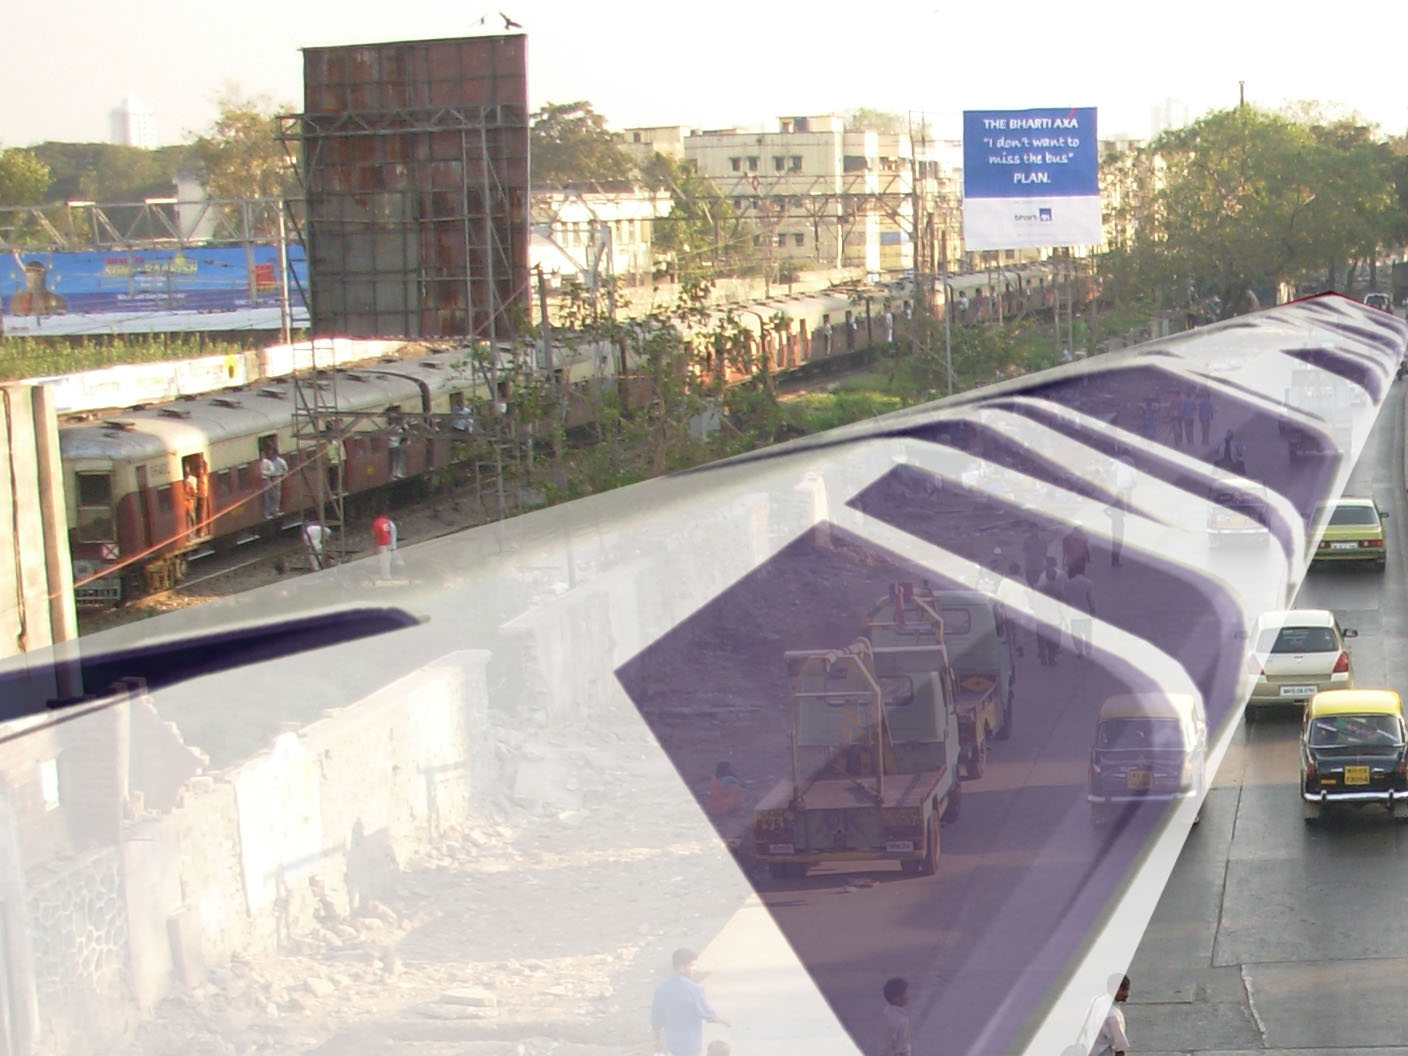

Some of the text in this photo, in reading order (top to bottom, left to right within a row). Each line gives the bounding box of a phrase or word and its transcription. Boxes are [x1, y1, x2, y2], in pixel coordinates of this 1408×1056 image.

[983, 117, 1079, 129] THE BHARTI AXA
[996, 136, 1030, 148] don't
[1032, 137, 1066, 148] want
[1067, 136, 1080, 147] to
[989, 151, 1021, 164] miss
[1023, 152, 1043, 164] the
[1013, 172, 1051, 184] PLAN.
